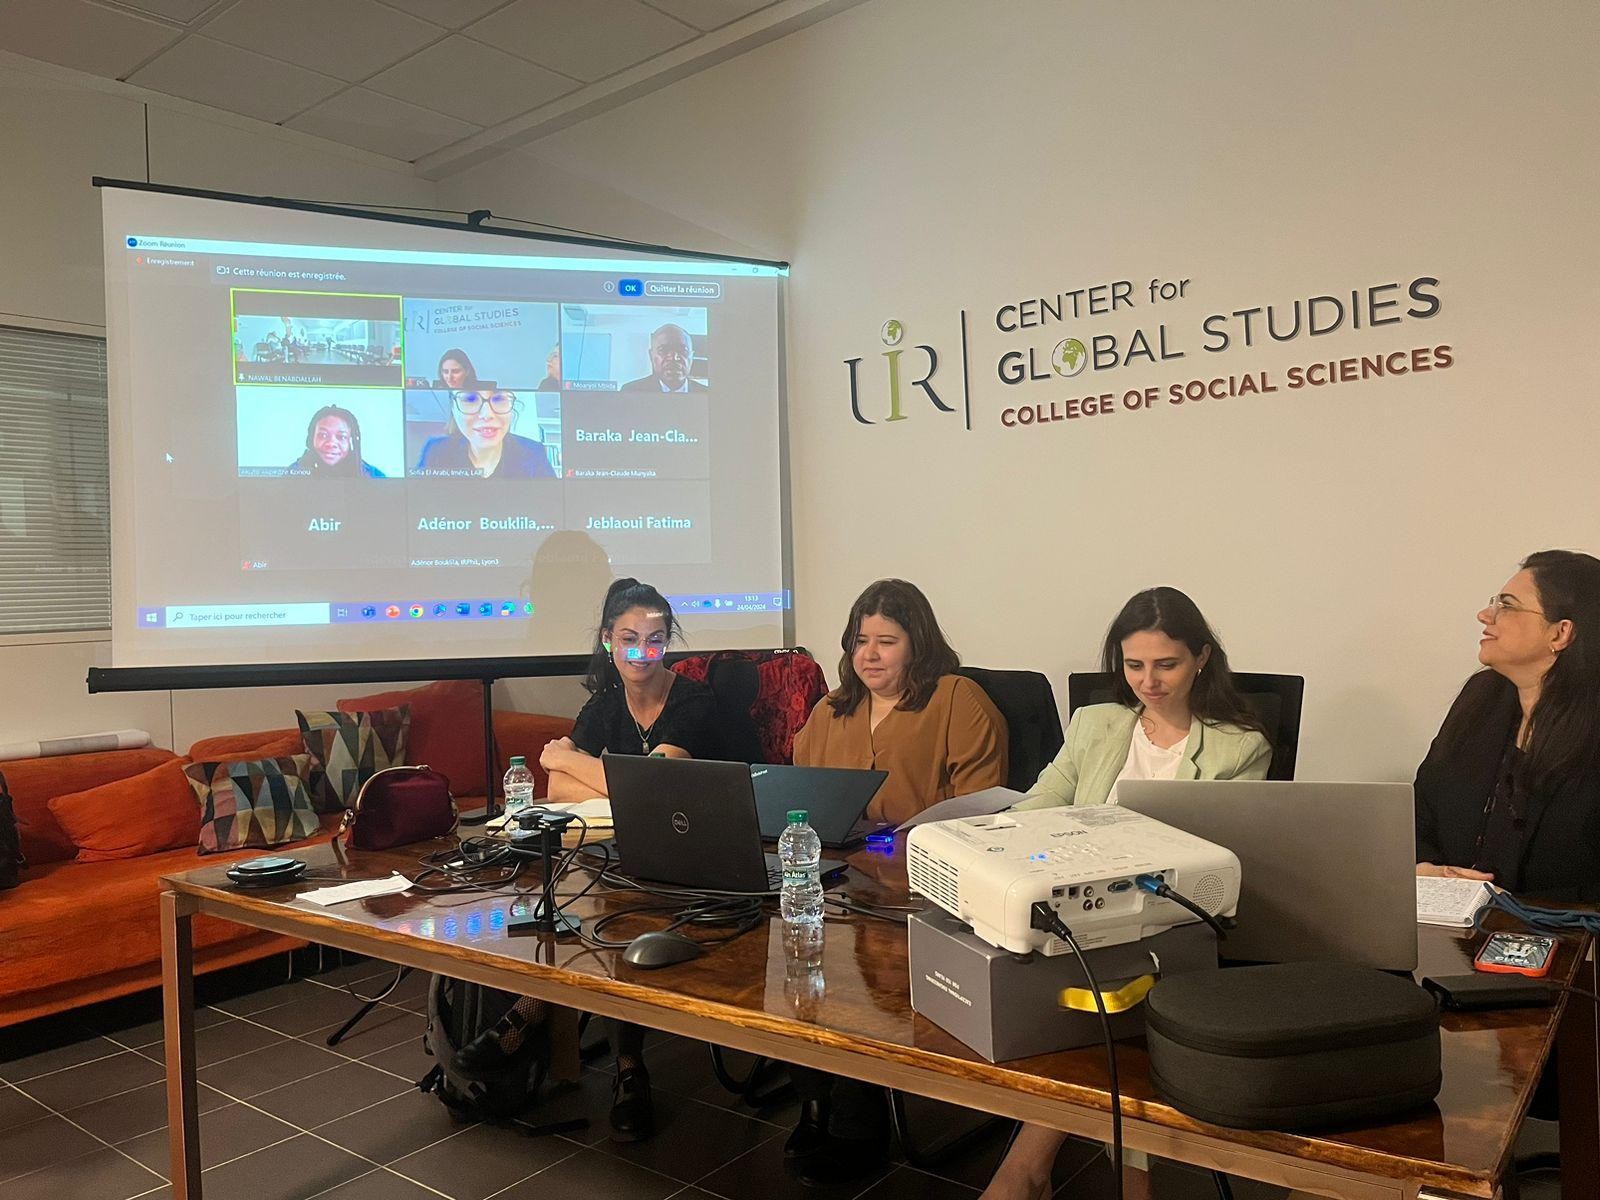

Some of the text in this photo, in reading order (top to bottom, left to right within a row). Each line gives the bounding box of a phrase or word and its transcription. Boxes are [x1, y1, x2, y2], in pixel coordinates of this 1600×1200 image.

[139, 239, 158, 248] Zoom
[146, 257, 194, 266] Enregistrement
[232, 267, 346, 281] Cette réunion est enregistrée.
[650, 285, 676, 294] Quitter
[686, 286, 714, 295] réunion
[995, 277, 1191, 333] CENTER for
[474, 307, 520, 321] STUDIES
[996, 275, 1442, 385] GLOBAL STUDIES
[1000, 344, 1454, 428] COLLEGE OF SOCIAL SCIENCES
[576, 428, 698, 444] Baraka Jean-Cla...
[308, 516, 341, 531] Abir
[417, 516, 554, 531] Adénor Bouklila,...
[586, 516, 691, 530] Jeblaoui Fatima
[190, 612, 286, 622] Taper ici pour rechercher
